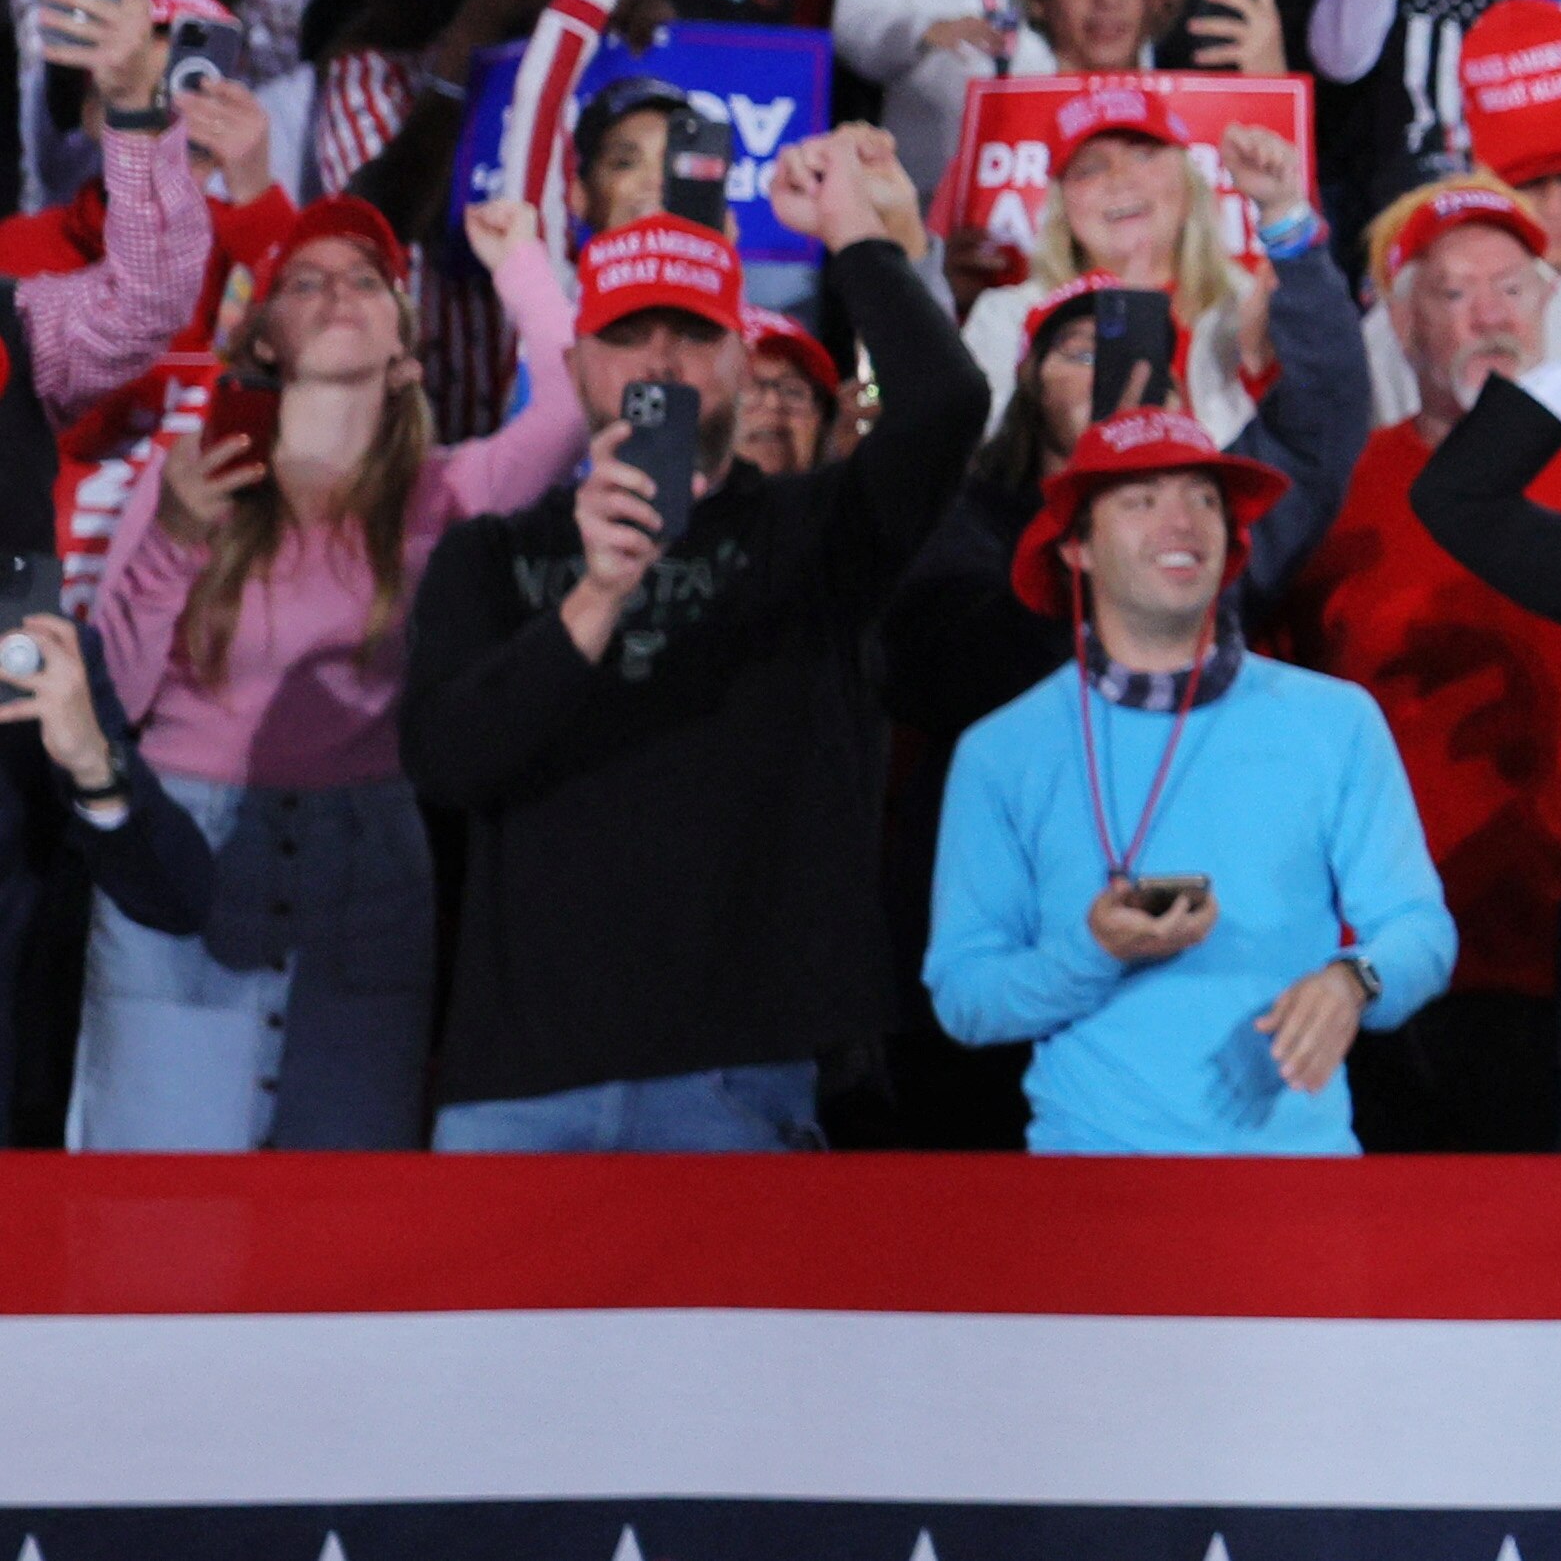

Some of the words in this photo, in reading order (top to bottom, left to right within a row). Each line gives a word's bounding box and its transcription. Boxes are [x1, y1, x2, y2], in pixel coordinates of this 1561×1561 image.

[588, 229, 642, 269] MAKE
[645, 227, 732, 271] AMERICA
[596, 256, 661, 294] GREAT
[663, 258, 723, 295] AGAIN
